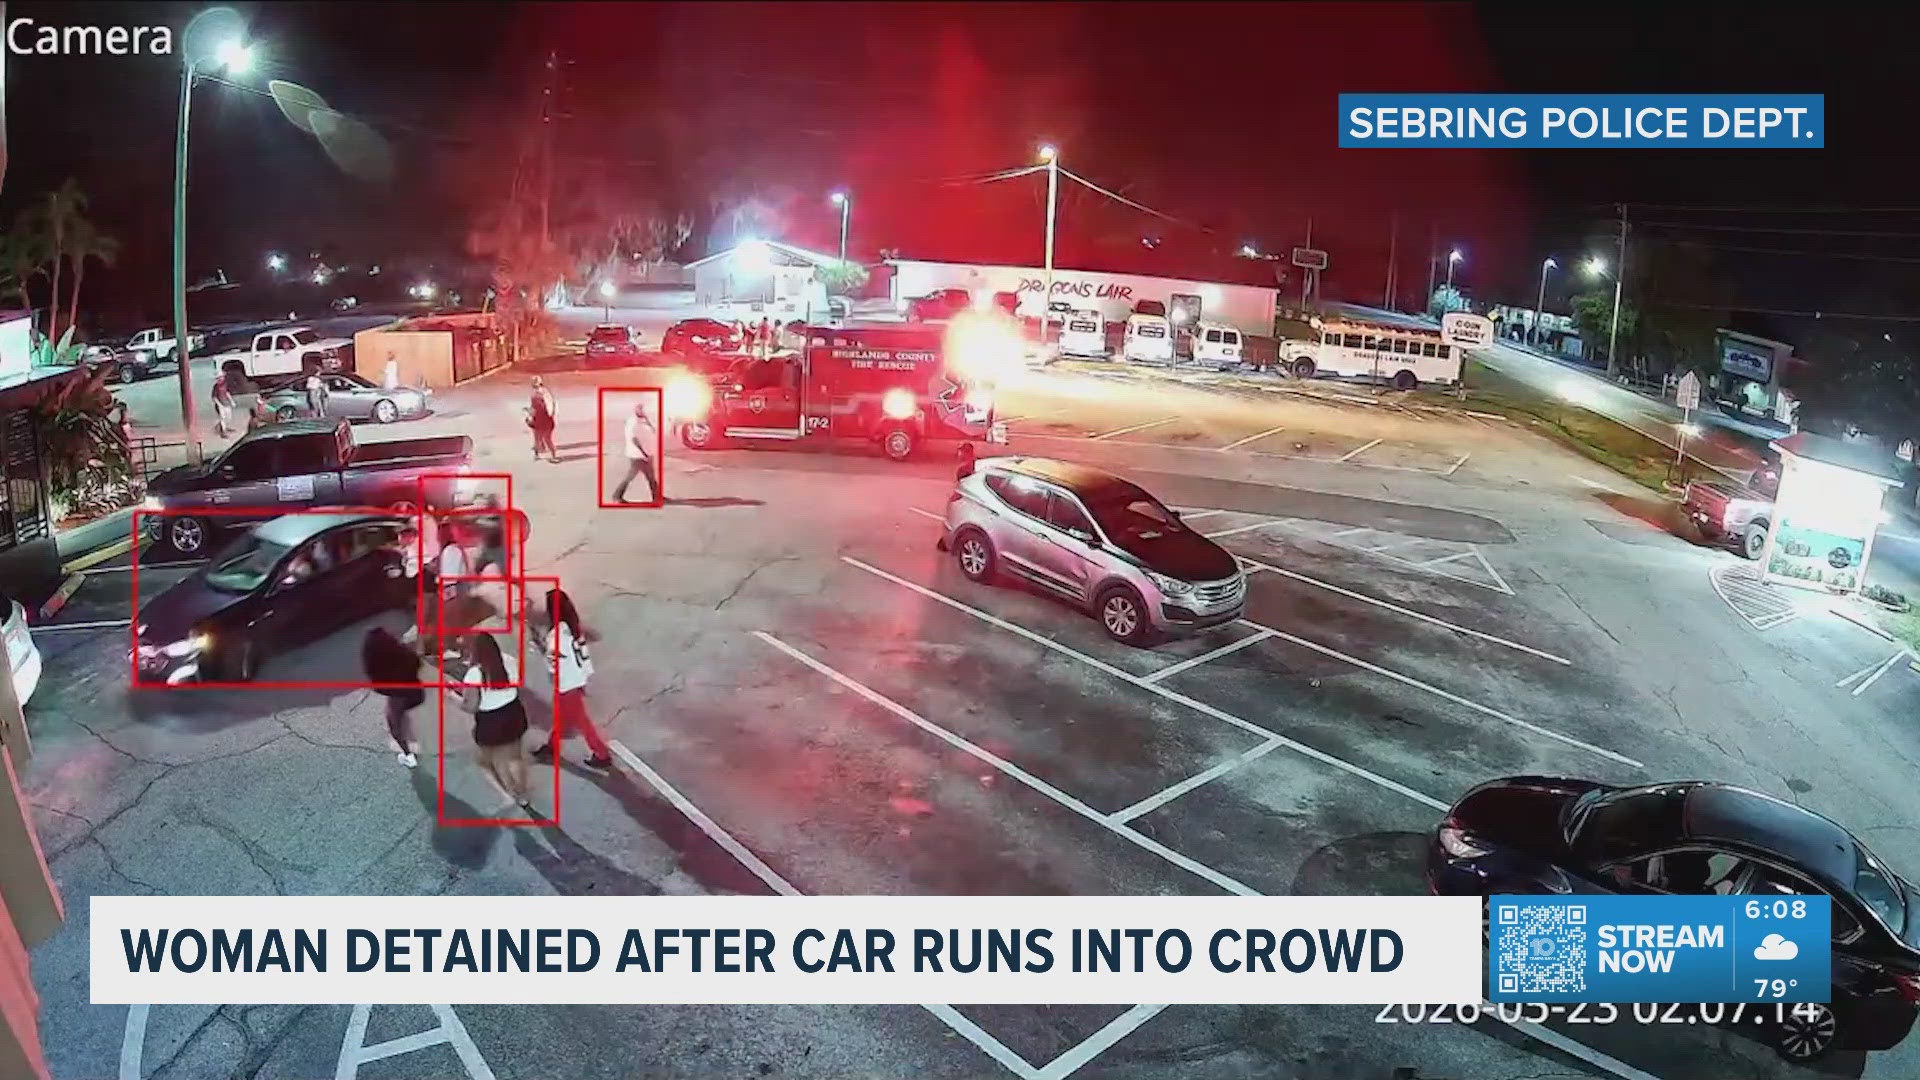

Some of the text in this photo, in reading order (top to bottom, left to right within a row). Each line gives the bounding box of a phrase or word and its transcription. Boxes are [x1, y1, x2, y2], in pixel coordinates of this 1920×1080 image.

[1096, 283, 1132, 300] LAIR
[1455, 319, 1482, 330] COIN
[1447, 327, 1486, 340] LAUNDRY
[895, 352, 935, 362] COUNTY
[851, 360, 916, 371] FIRE RESCUE
[808, 416, 829, 428] 17-2
